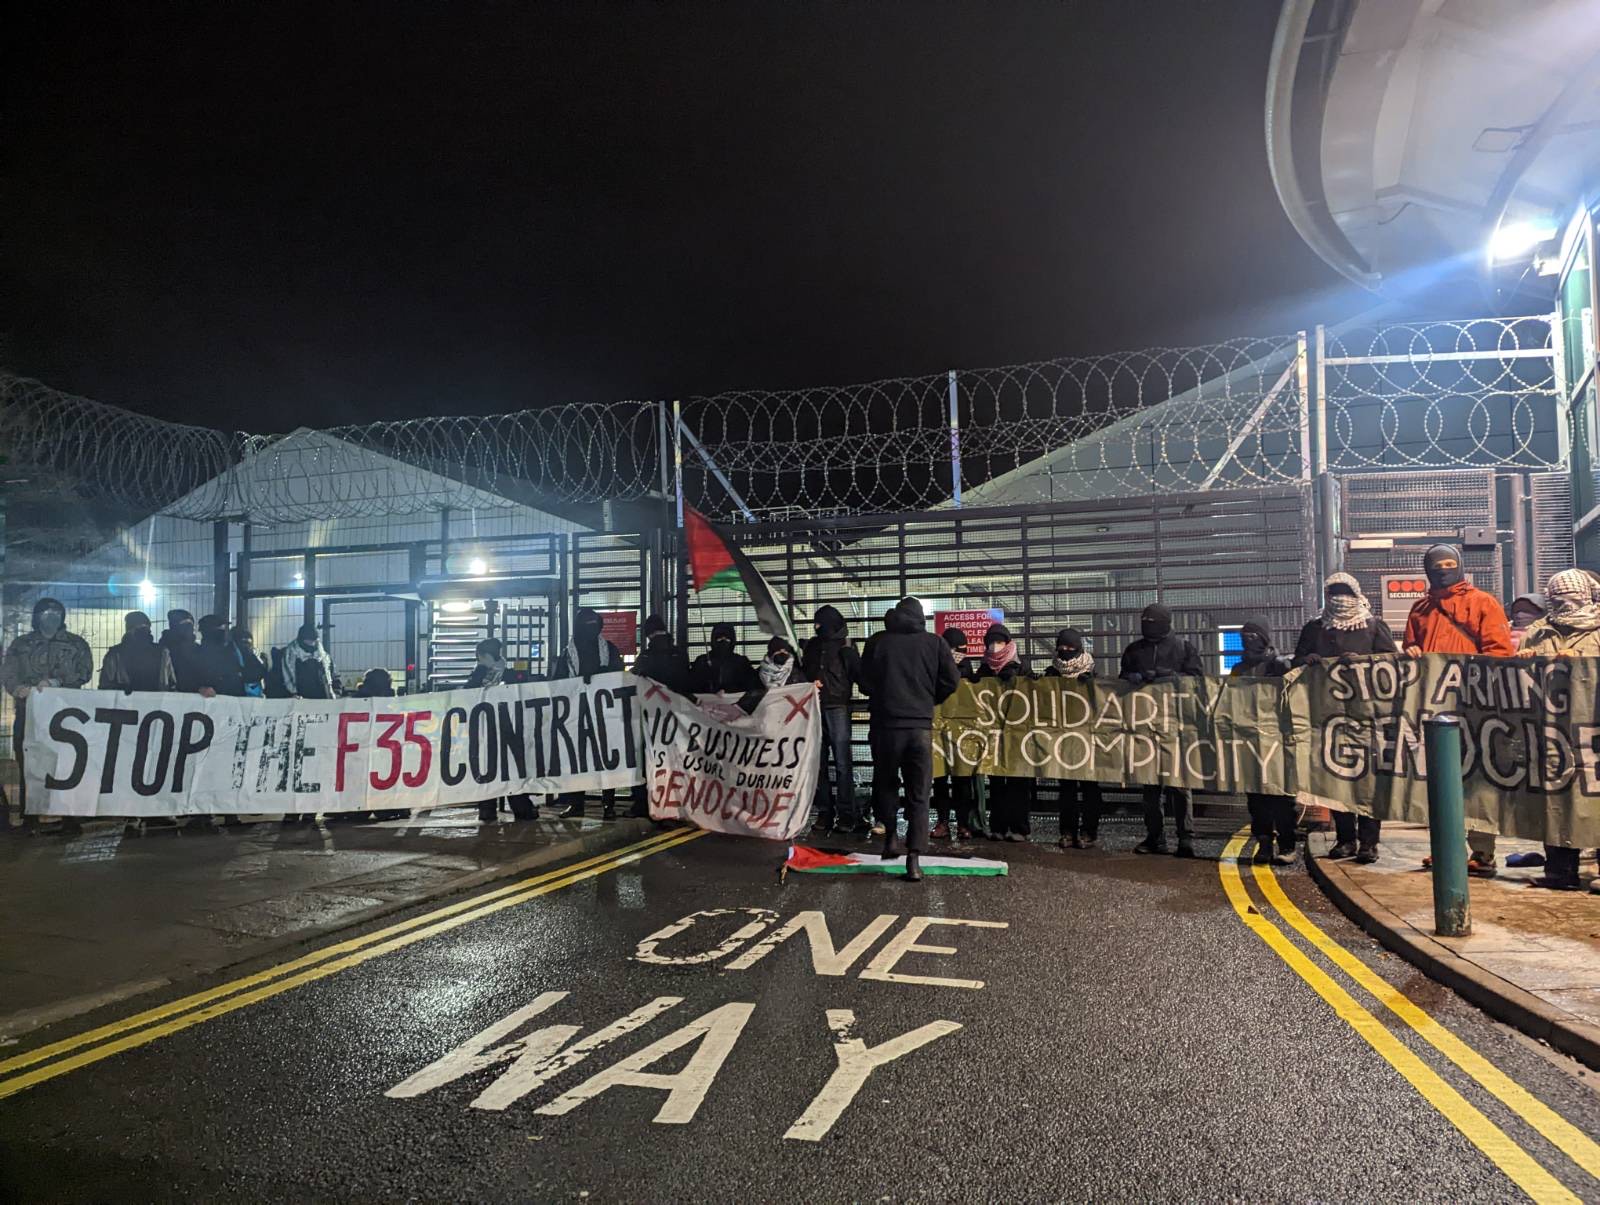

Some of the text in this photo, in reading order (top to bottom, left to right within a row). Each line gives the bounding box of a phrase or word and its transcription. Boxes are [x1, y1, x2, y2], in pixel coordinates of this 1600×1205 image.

[944, 621, 992, 629] EMERGENCY
[975, 689, 1222, 733] SOLIDARITY
[1329, 660, 1572, 714] STOP ARMING
[45, 685, 638, 796] STOP THE F35 CONTRACT
[643, 707, 806, 770] NO BUSINESS
[931, 729, 1280, 785] NOT COMPLICITY
[650, 768, 797, 829] GENOCIDE
[683, 755, 725, 780] USUAL
[736, 771, 793, 790] DURING
[626, 907, 1009, 989] ONE
[383, 990, 964, 1142] WAY
